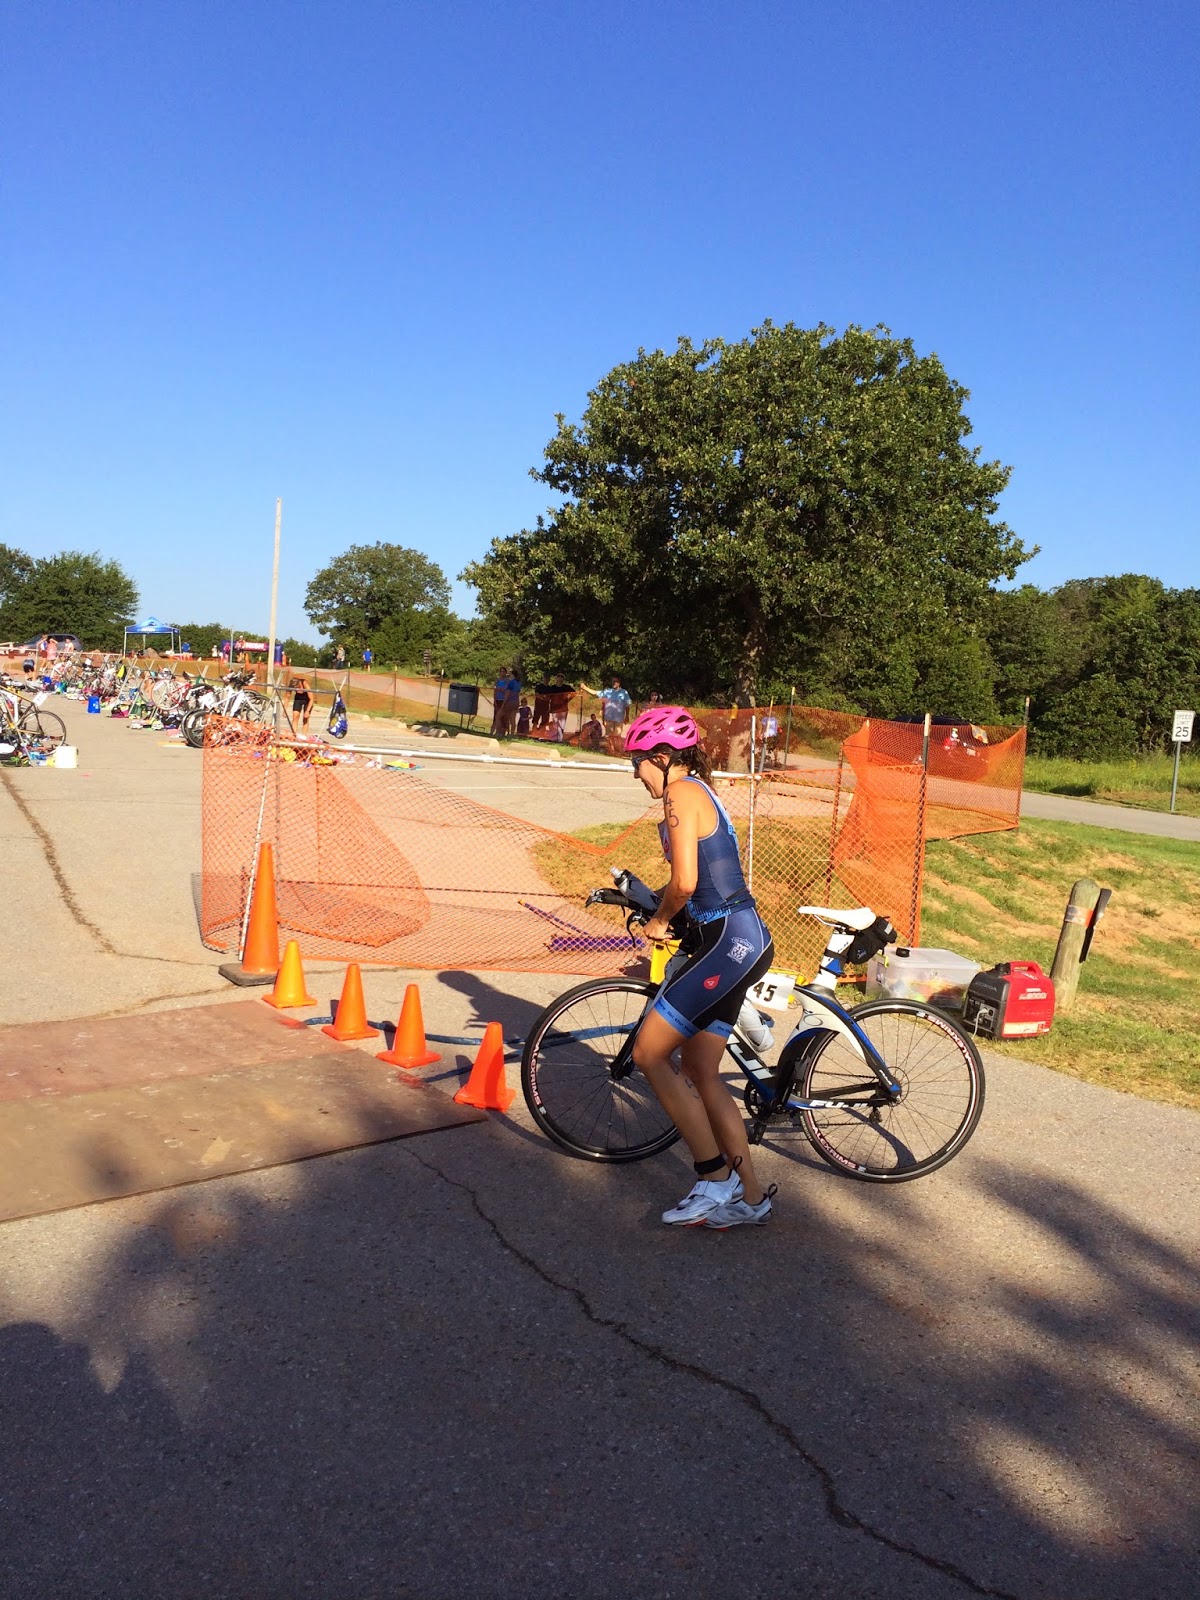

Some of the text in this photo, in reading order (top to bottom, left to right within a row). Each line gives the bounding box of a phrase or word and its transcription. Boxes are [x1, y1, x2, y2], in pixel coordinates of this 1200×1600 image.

[1175, 726, 1190, 737] 25
[753, 981, 778, 1002] 45
[974, 981, 998, 992] HONDA
